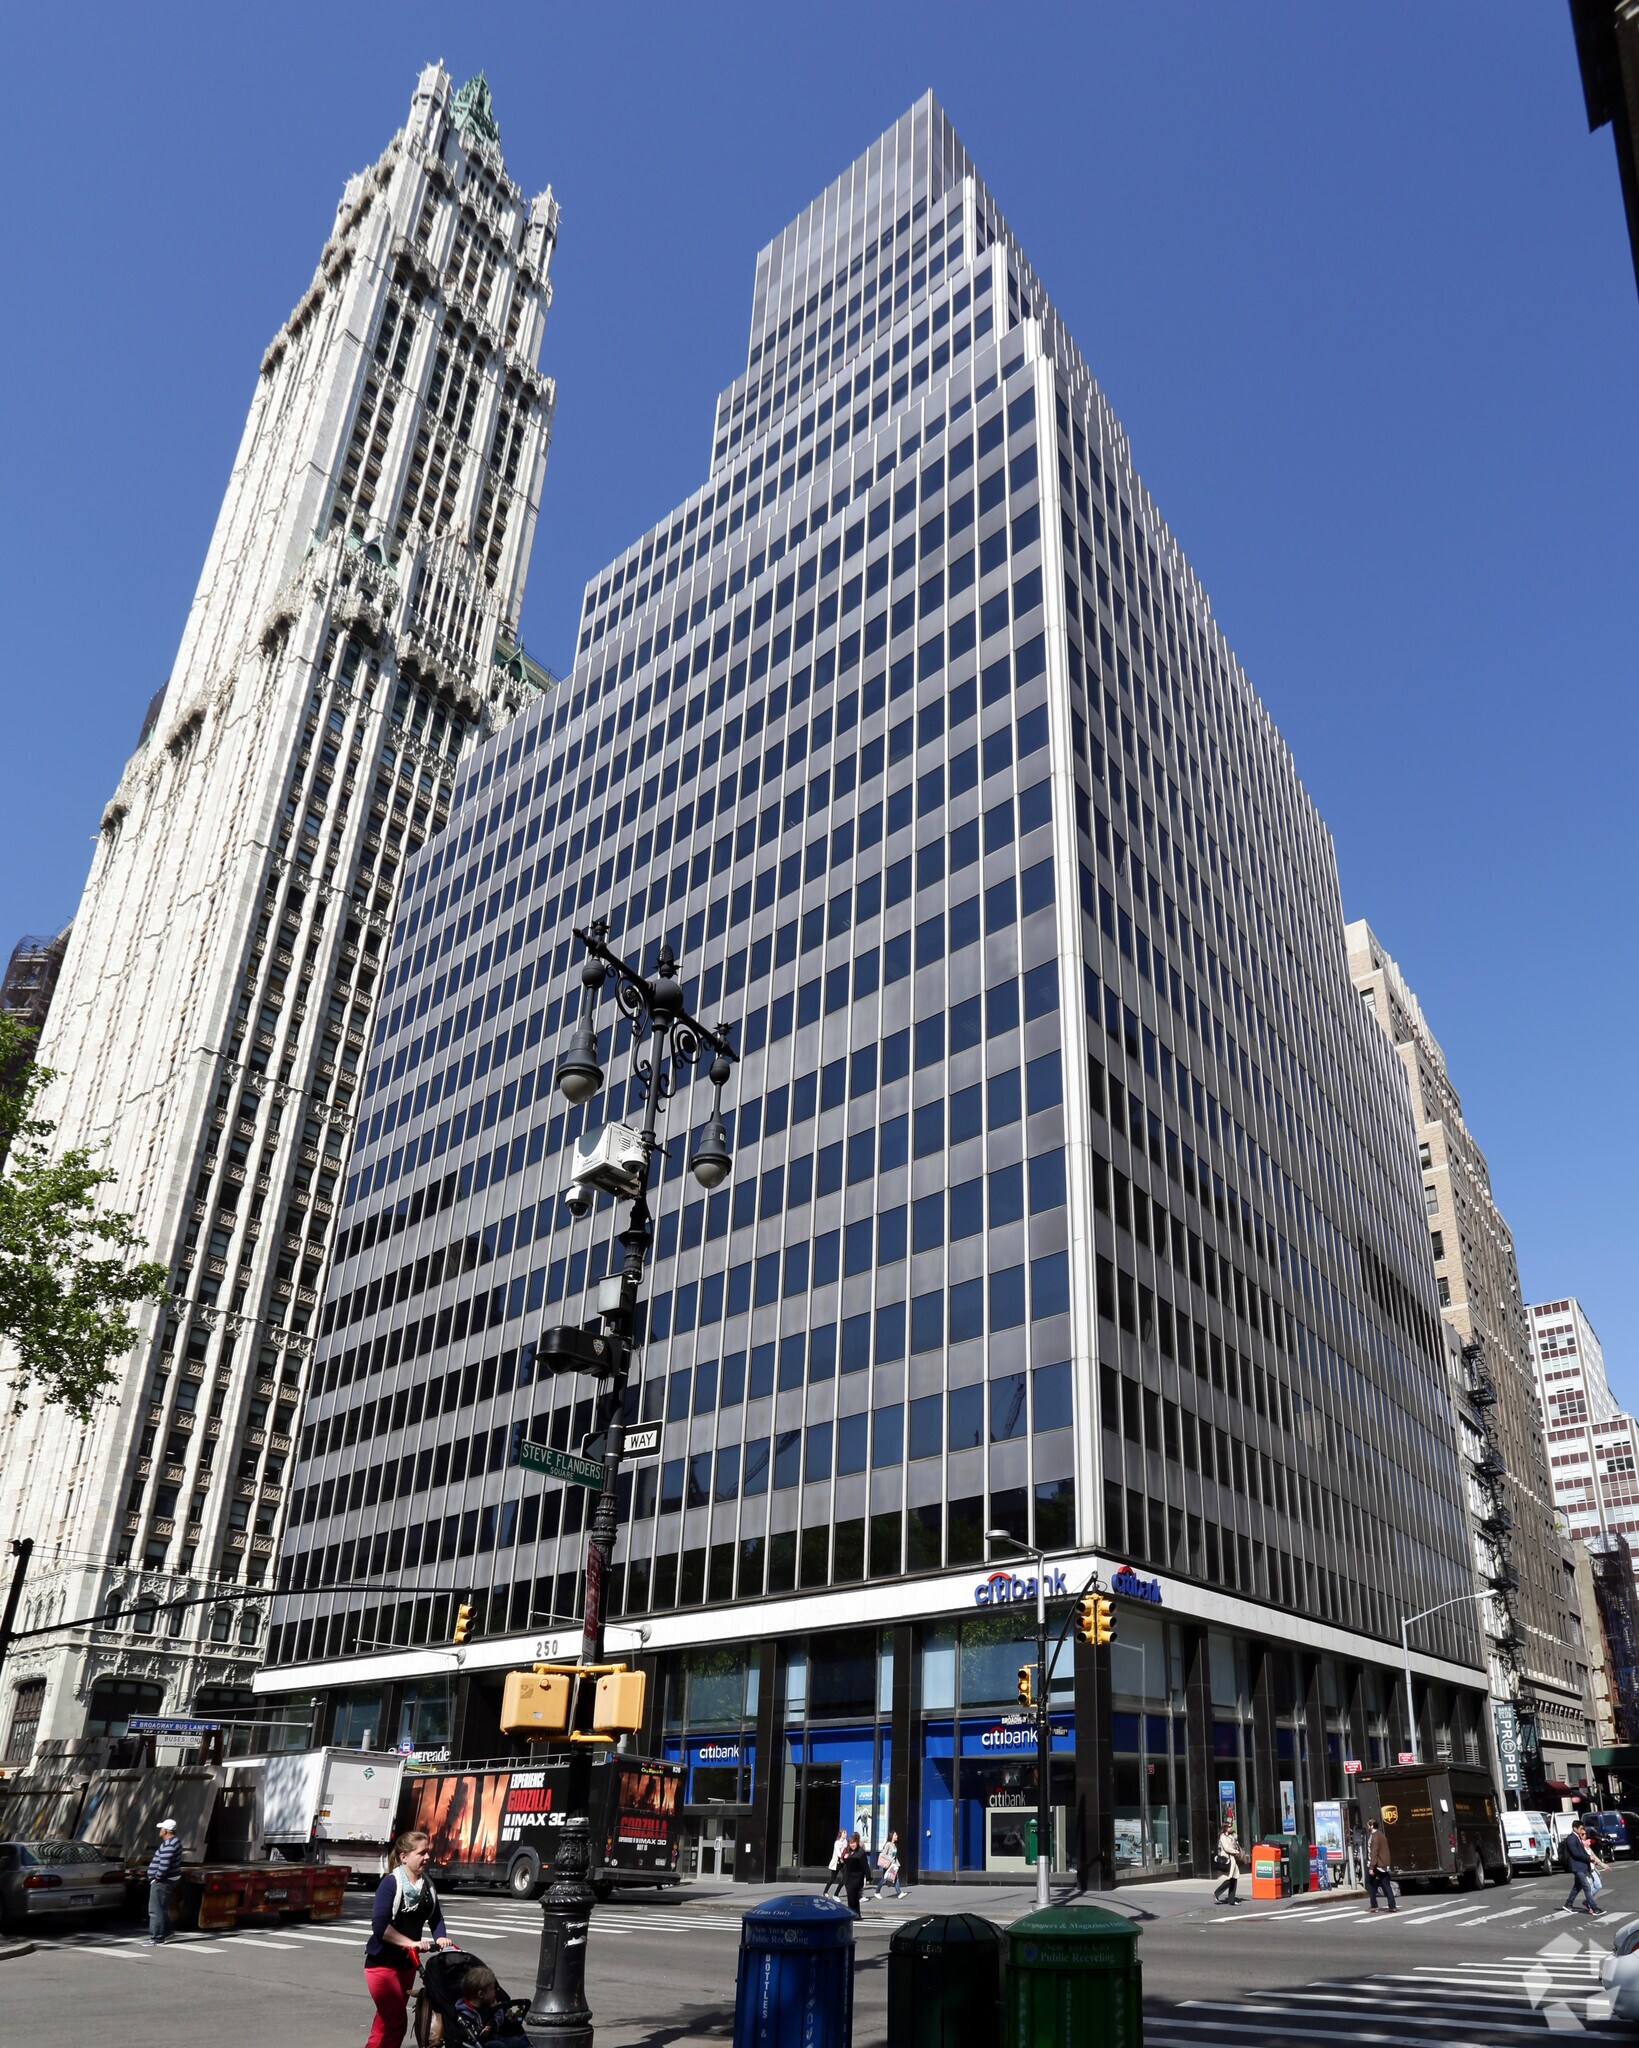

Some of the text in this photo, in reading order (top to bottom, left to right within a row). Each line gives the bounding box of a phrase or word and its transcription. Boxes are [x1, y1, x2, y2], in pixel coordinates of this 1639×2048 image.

[630, 1433, 653, 1448] WAY
[522, 1443, 602, 1480] STEVE FLANDERS
[550, 1466, 574, 1480] SQUARE
[974, 1567, 1067, 1604] citibank
[536, 1639, 559, 1657] 250
[982, 1727, 1038, 1746] citibank
[700, 1744, 739, 1759] citibank
[510, 1772, 545, 1788] EXPERIENCE
[507, 1788, 552, 1812] GODZILLA
[989, 1787, 1026, 1807] citibank
[412, 1774, 510, 1863] IMAX
[511, 1813, 548, 1826] IMAX
[1383, 1810, 1397, 1821] ups
[620, 1816, 667, 1839] GODZILLA
[1041, 1951, 1116, 1964] Public Recycling
[762, 1953, 771, 2020] BOTTLES
